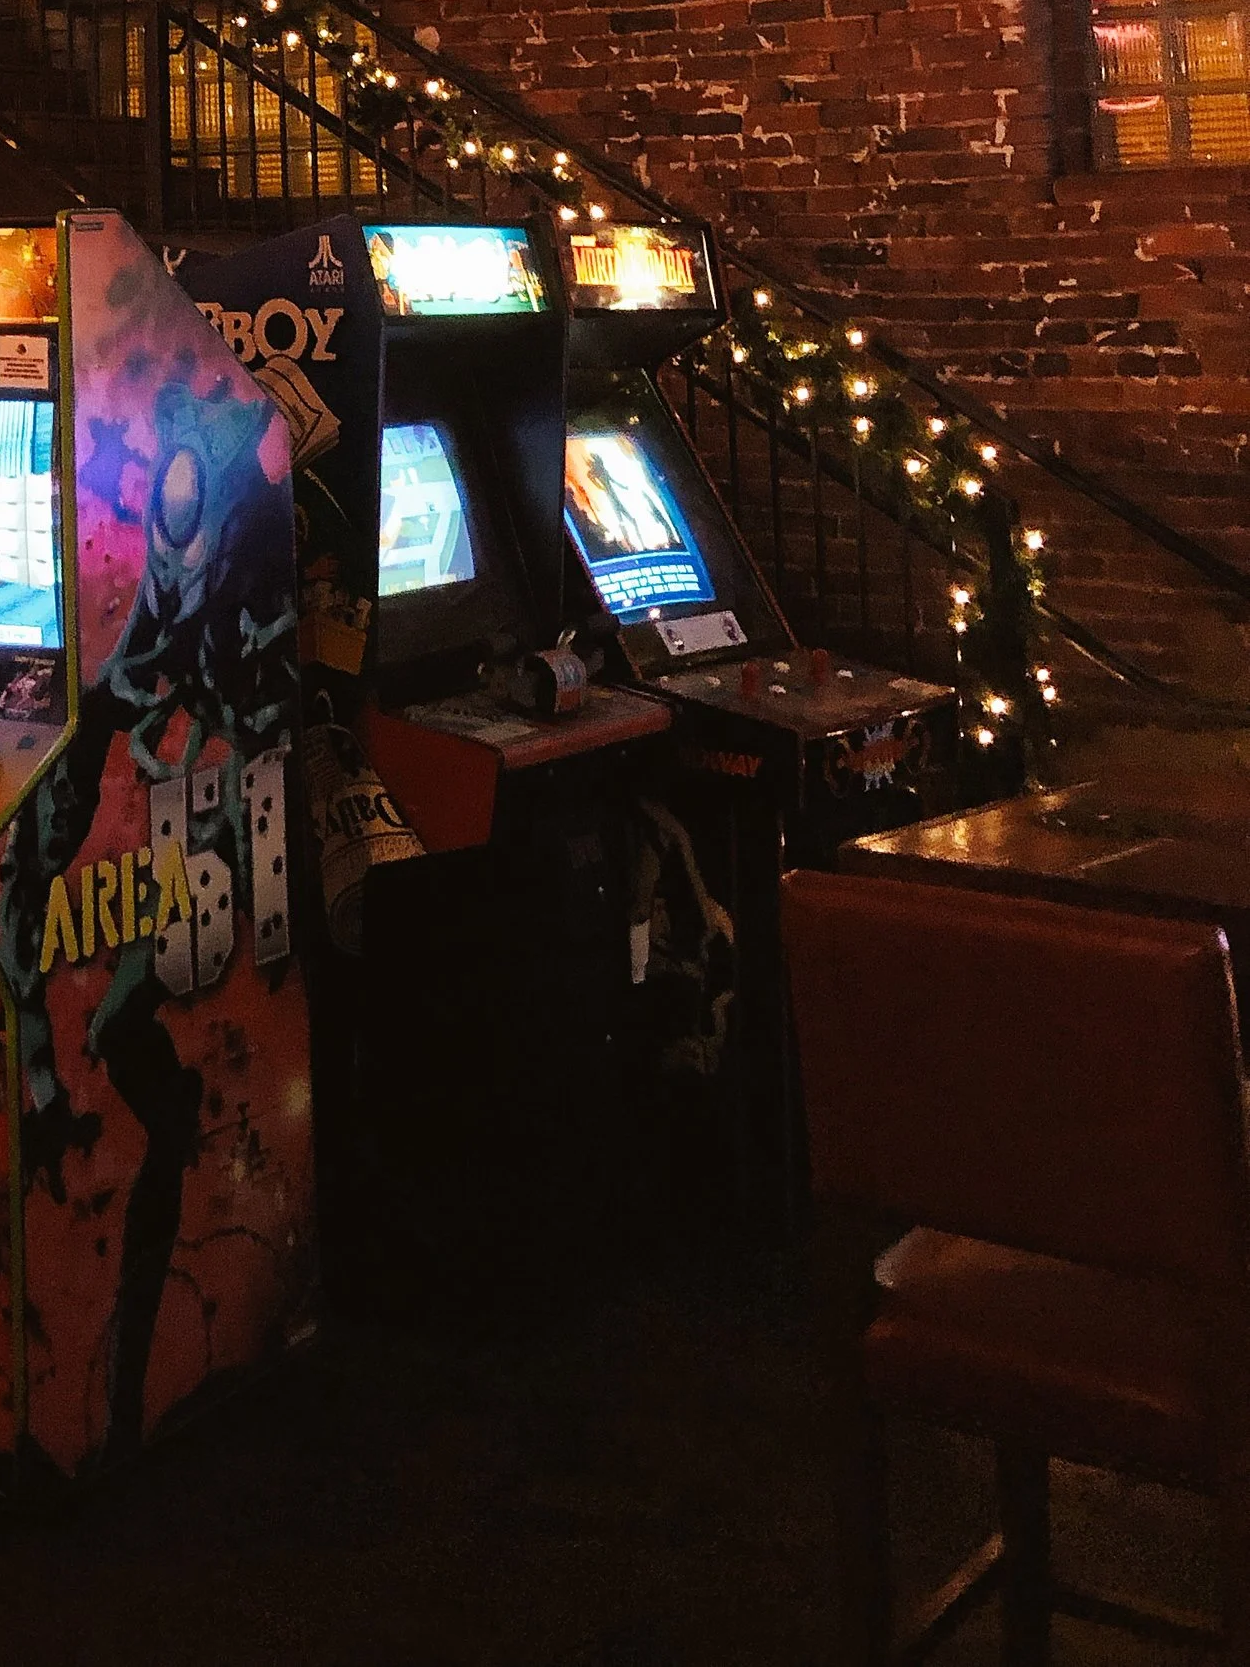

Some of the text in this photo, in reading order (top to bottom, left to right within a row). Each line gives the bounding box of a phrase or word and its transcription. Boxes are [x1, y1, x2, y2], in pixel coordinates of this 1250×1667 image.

[309, 269, 344, 286] ATARI
[573, 248, 695, 287] MORTA OMBAT
[39, 747, 291, 996] AREA 51
